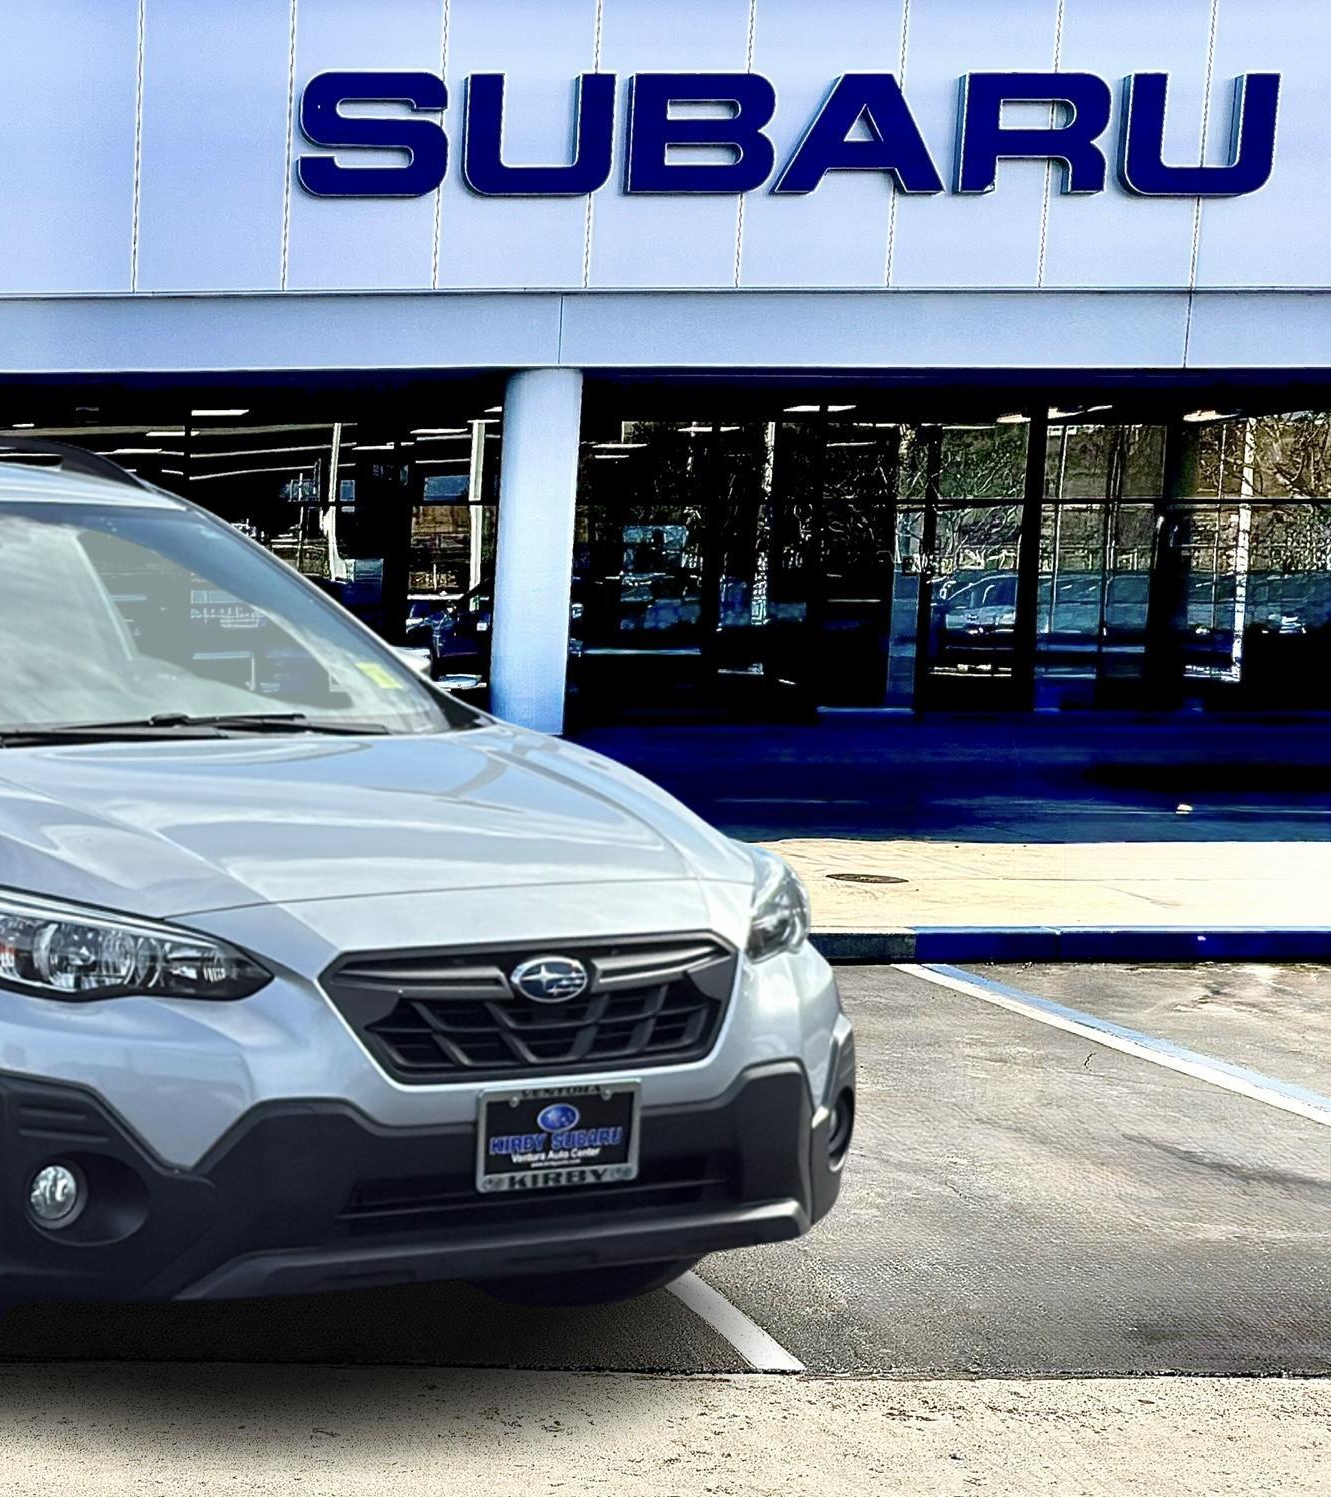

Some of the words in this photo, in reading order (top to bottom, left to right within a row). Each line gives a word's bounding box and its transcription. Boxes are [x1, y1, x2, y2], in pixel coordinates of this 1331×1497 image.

[295, 70, 1282, 198] SUBARU
[521, 1085, 602, 1099] VENTURA
[489, 1132, 548, 1156] KIRBY
[551, 1126, 623, 1149] SUBARU
[511, 1151, 546, 1163] Ventura
[547, 1149, 569, 1161] Auto
[570, 1147, 601, 1158] Center
[508, 1168, 609, 1190] KIRBY
